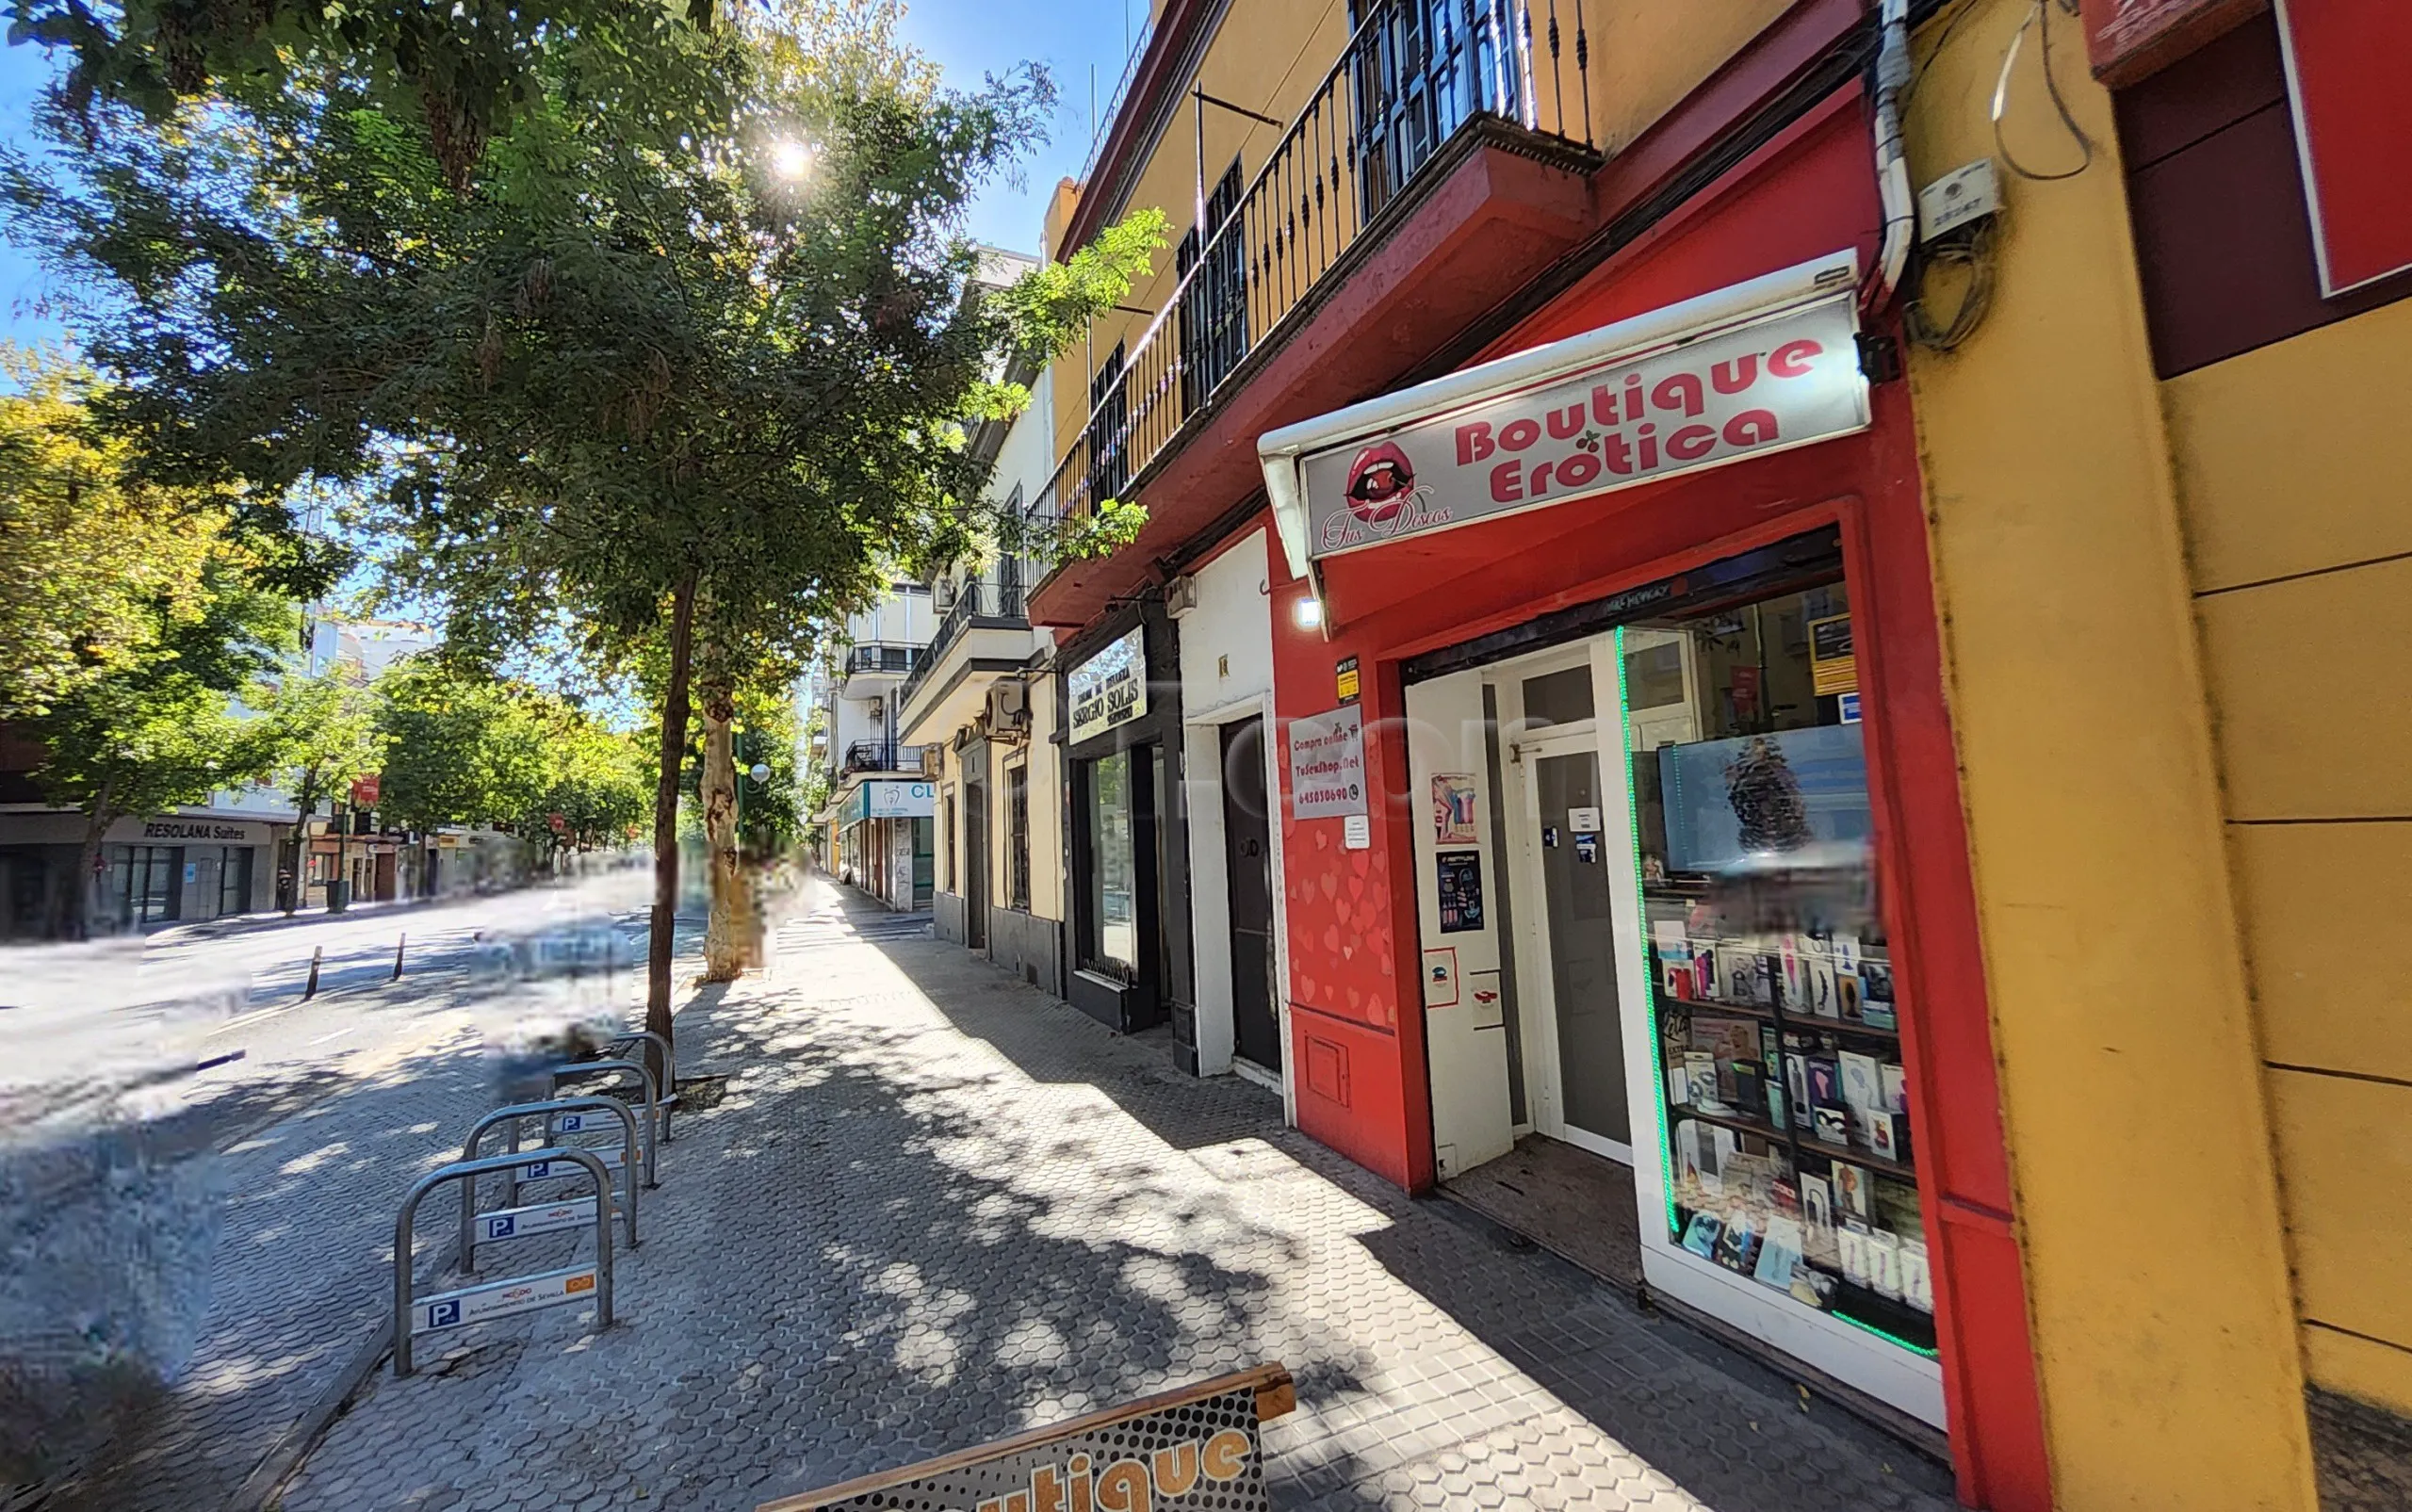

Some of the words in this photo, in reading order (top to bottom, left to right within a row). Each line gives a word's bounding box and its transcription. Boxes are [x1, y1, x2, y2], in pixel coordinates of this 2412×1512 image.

[1455, 339, 1824, 466] Boutique
[1073, 697, 1103, 729] SERGIO
[1294, 738, 1322, 752] Compra
[144, 823, 210, 838] RESOLANA
[214, 825, 245, 839] Suites
[432, 1304, 452, 1325] P
